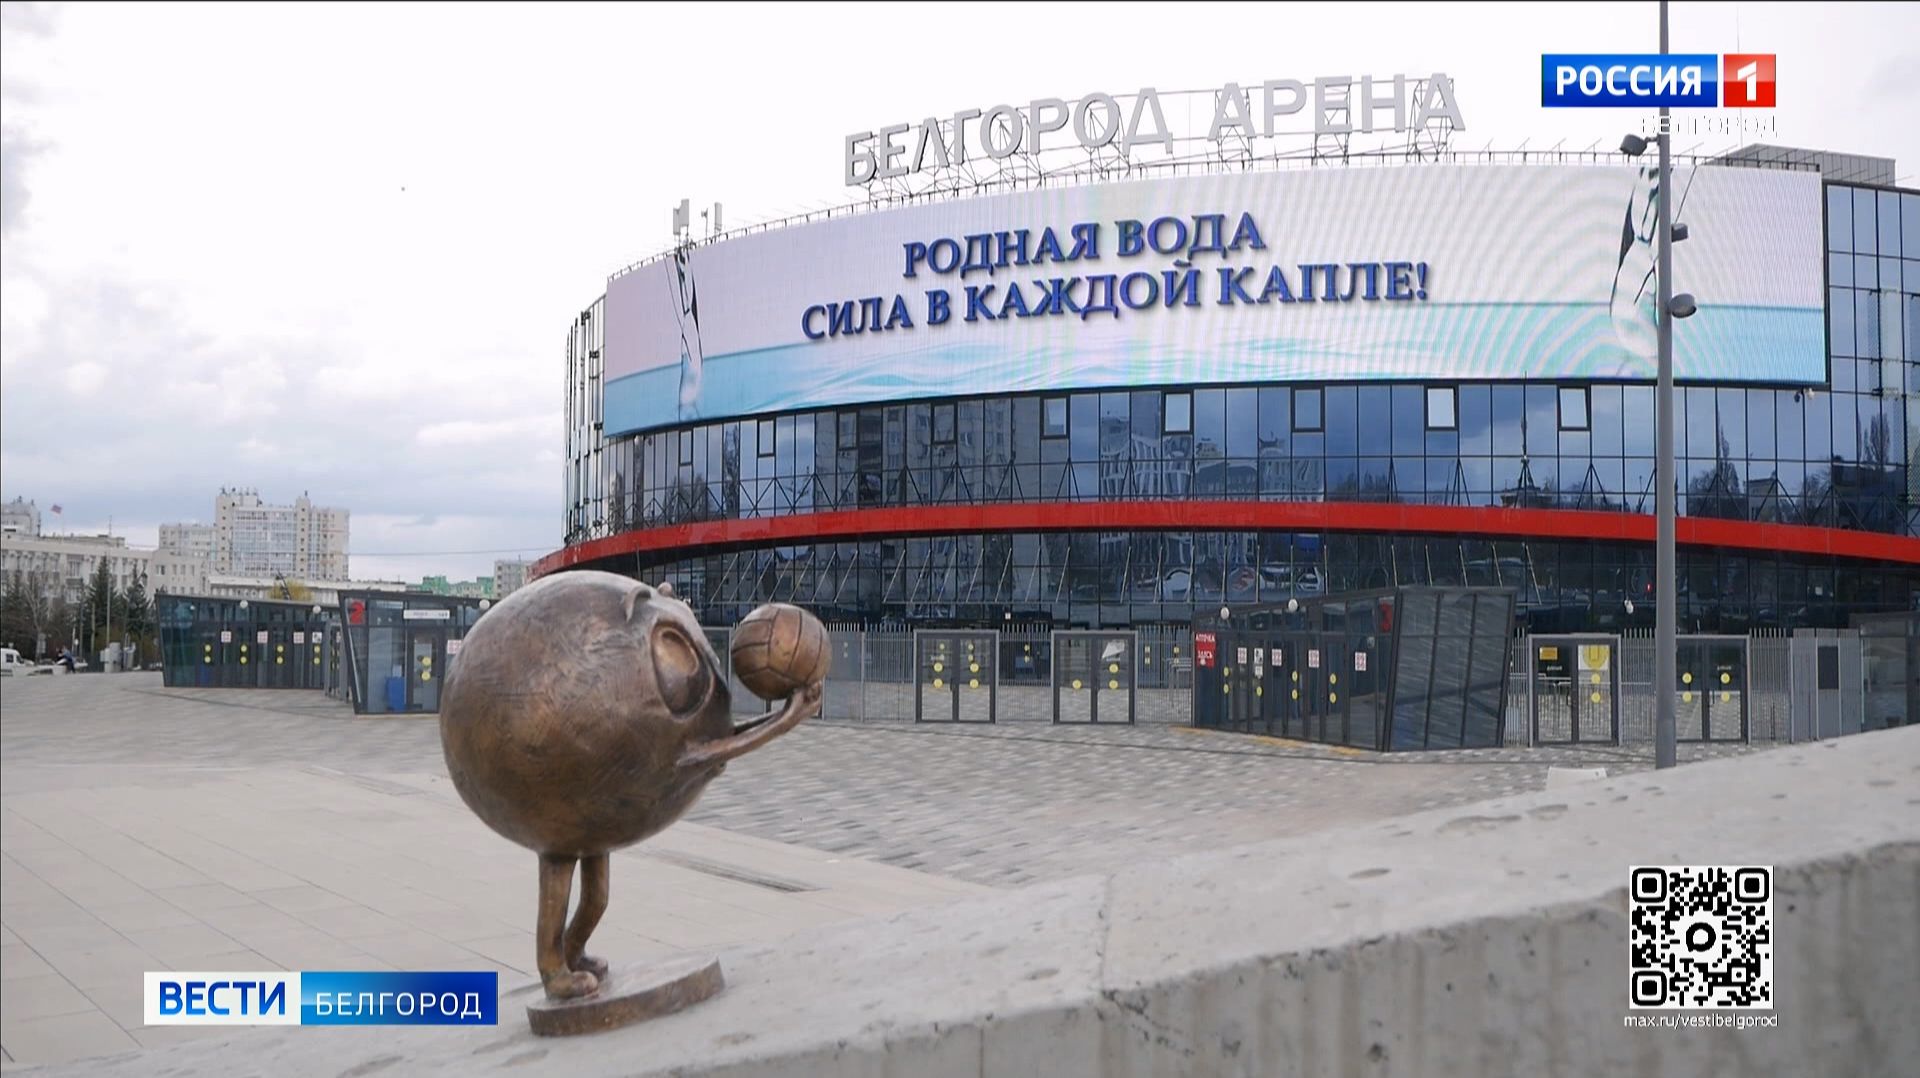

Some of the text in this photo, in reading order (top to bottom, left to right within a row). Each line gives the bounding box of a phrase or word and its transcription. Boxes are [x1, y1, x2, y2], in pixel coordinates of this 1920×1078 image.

[845, 72, 1465, 186] БЕЛГОРОД АРЕНА
[902, 212, 1266, 278] РОДНАЯ ВОДА
[802, 259, 1430, 341] СИЛА В КАЖДОЙ КАПЛЕ!
